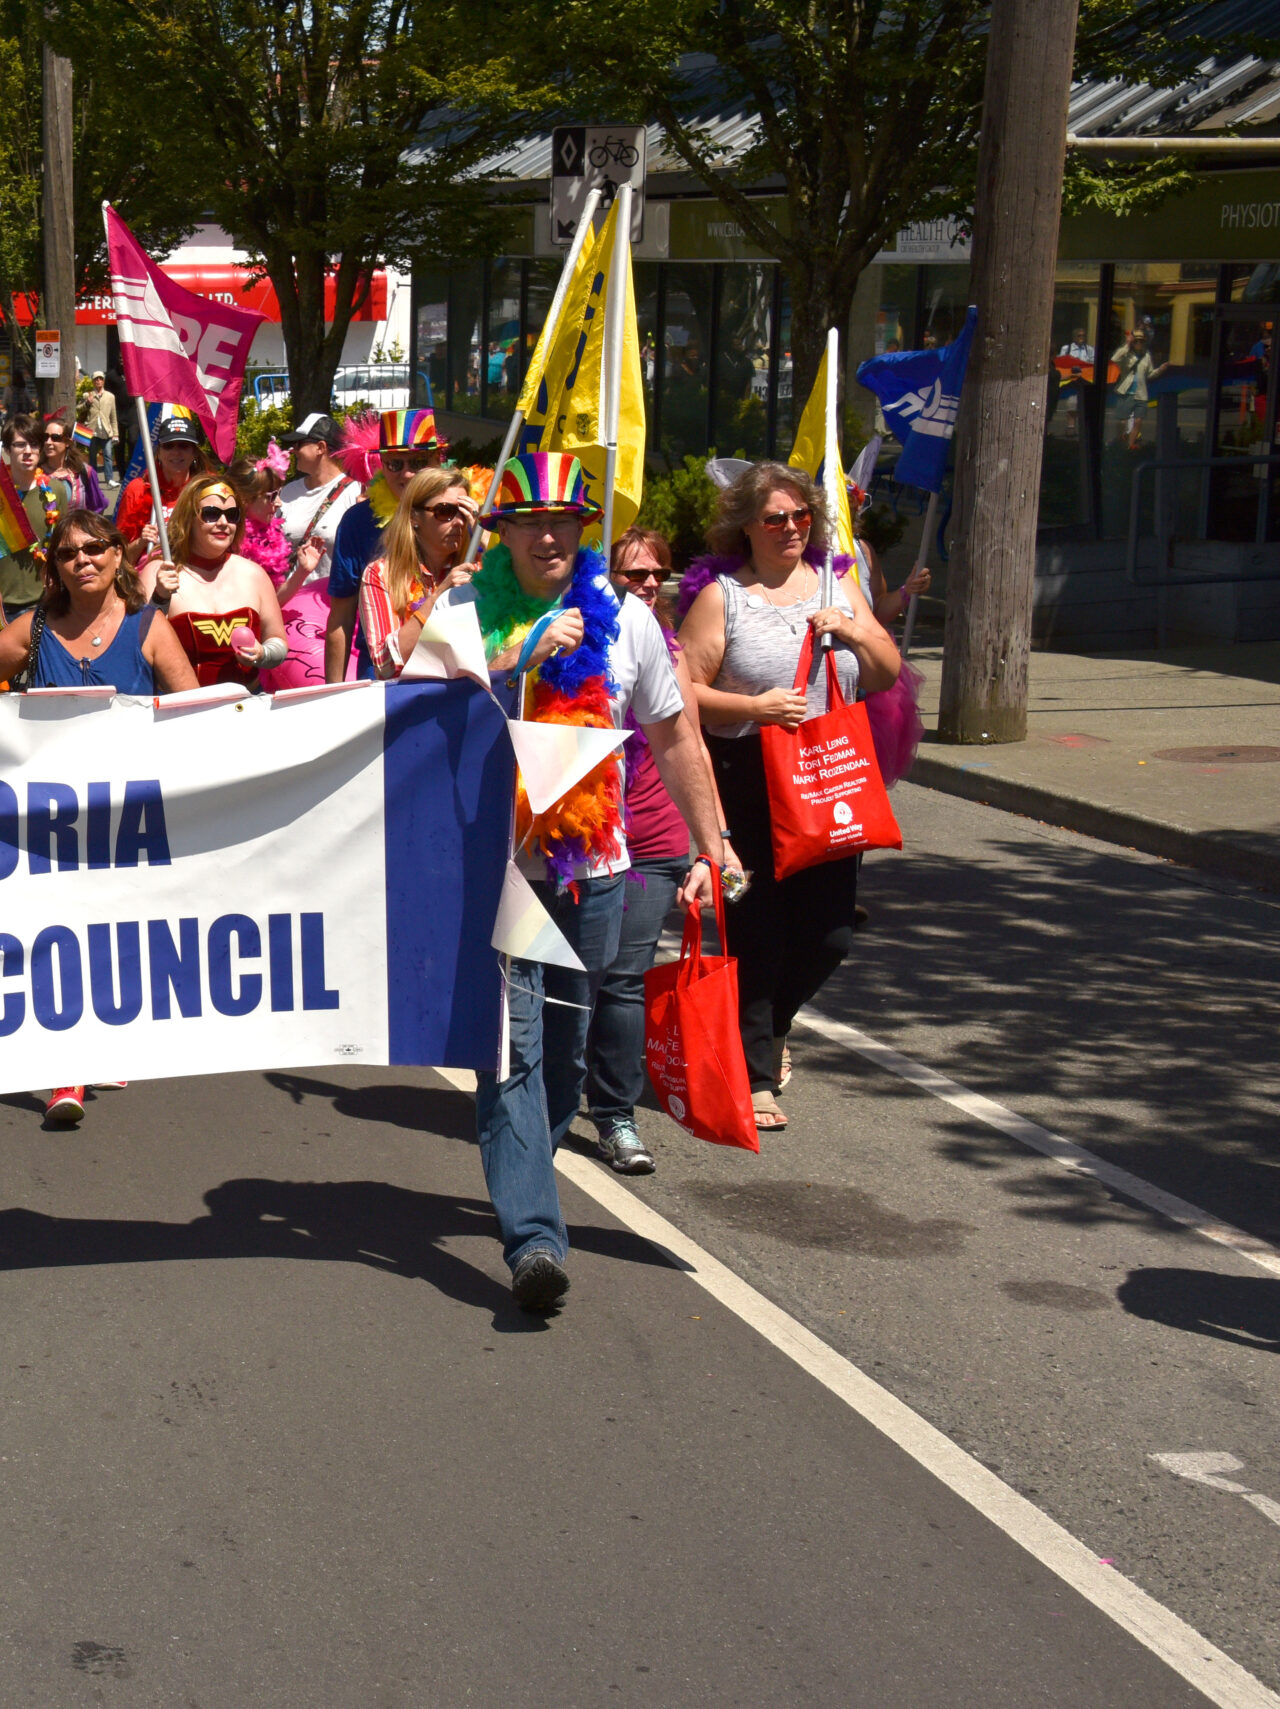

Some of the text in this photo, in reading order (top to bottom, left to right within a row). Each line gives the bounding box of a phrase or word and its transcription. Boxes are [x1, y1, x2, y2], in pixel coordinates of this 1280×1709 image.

[799, 744, 825, 758] KARL
[797, 758, 821, 772] TORI
[829, 823, 863, 837] United Way
